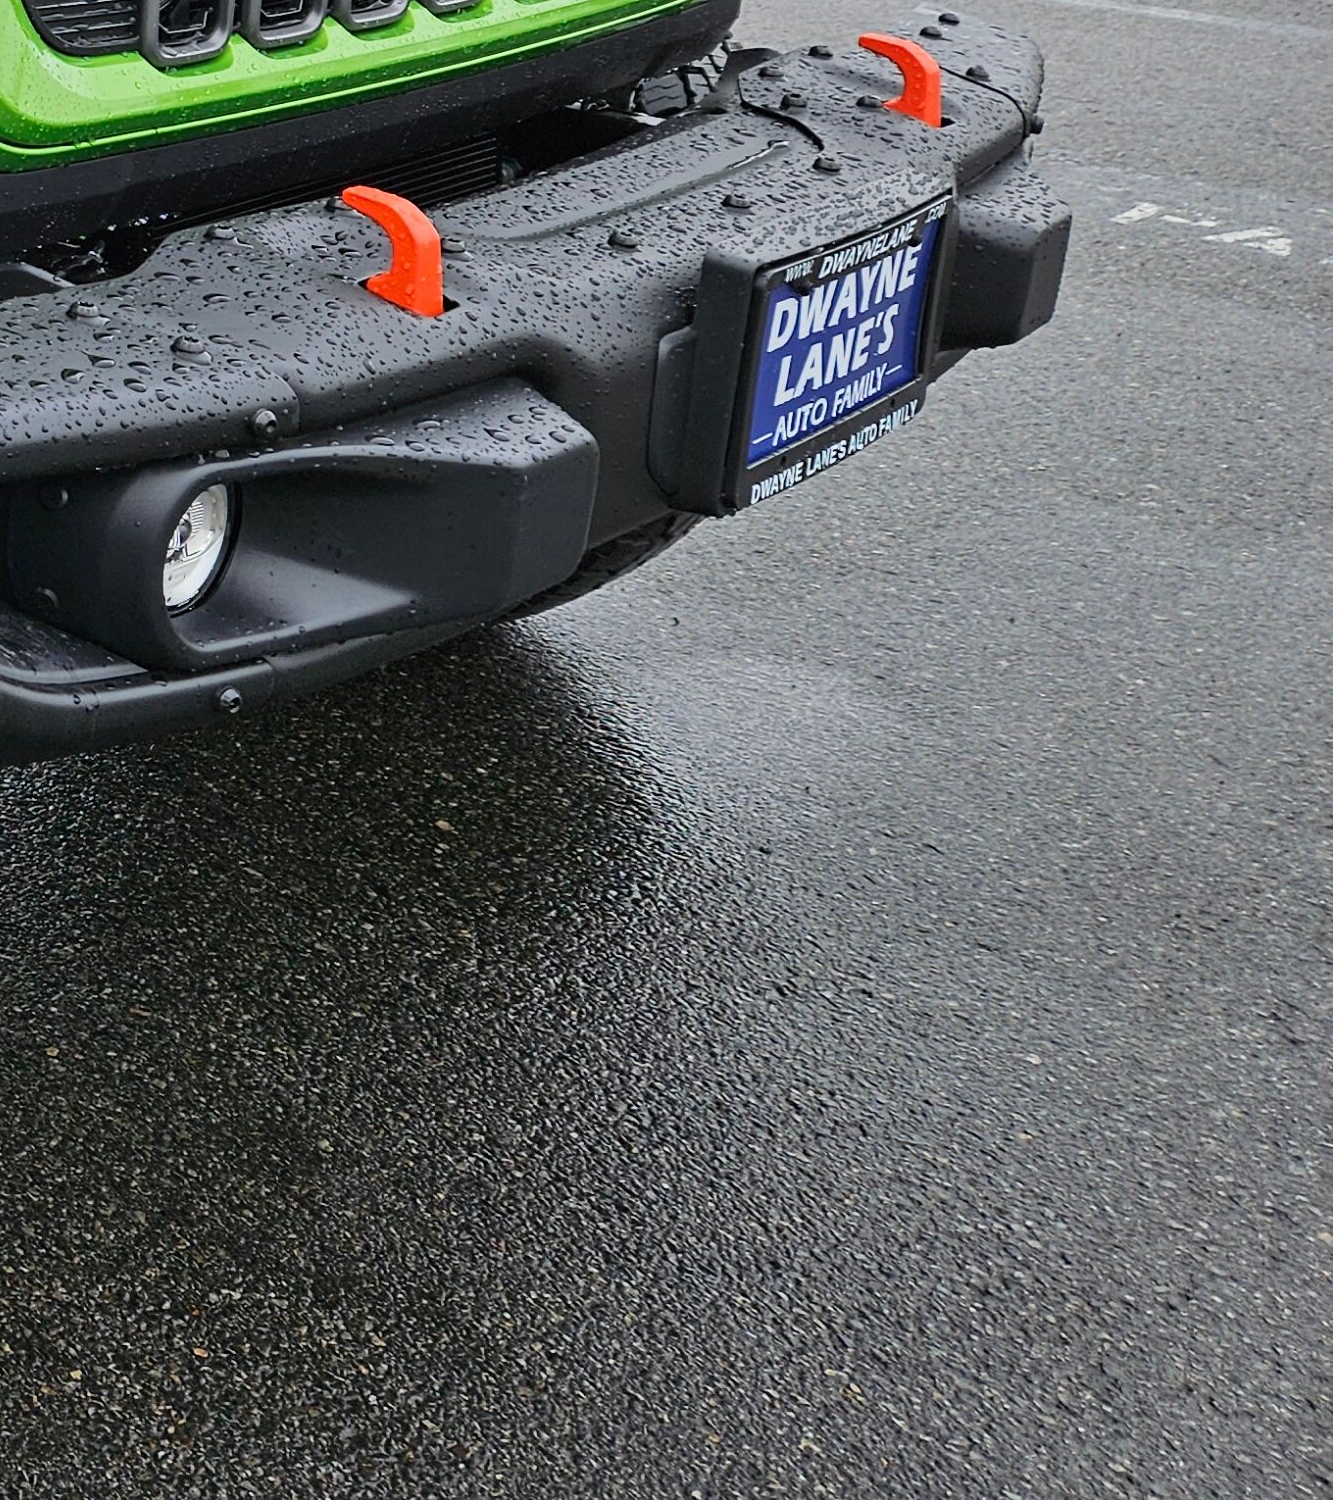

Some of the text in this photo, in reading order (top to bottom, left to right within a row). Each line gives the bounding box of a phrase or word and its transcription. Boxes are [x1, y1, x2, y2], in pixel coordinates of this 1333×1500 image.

[766, 242, 923, 353] DWAYNE
[819, 220, 917, 279] DWAYNELANE
[771, 363, 887, 446] AUTO FAMILY
[773, 303, 899, 407] LANE'S
[750, 399, 919, 504] DWAYNE LANE'S AUTO FAMILY
